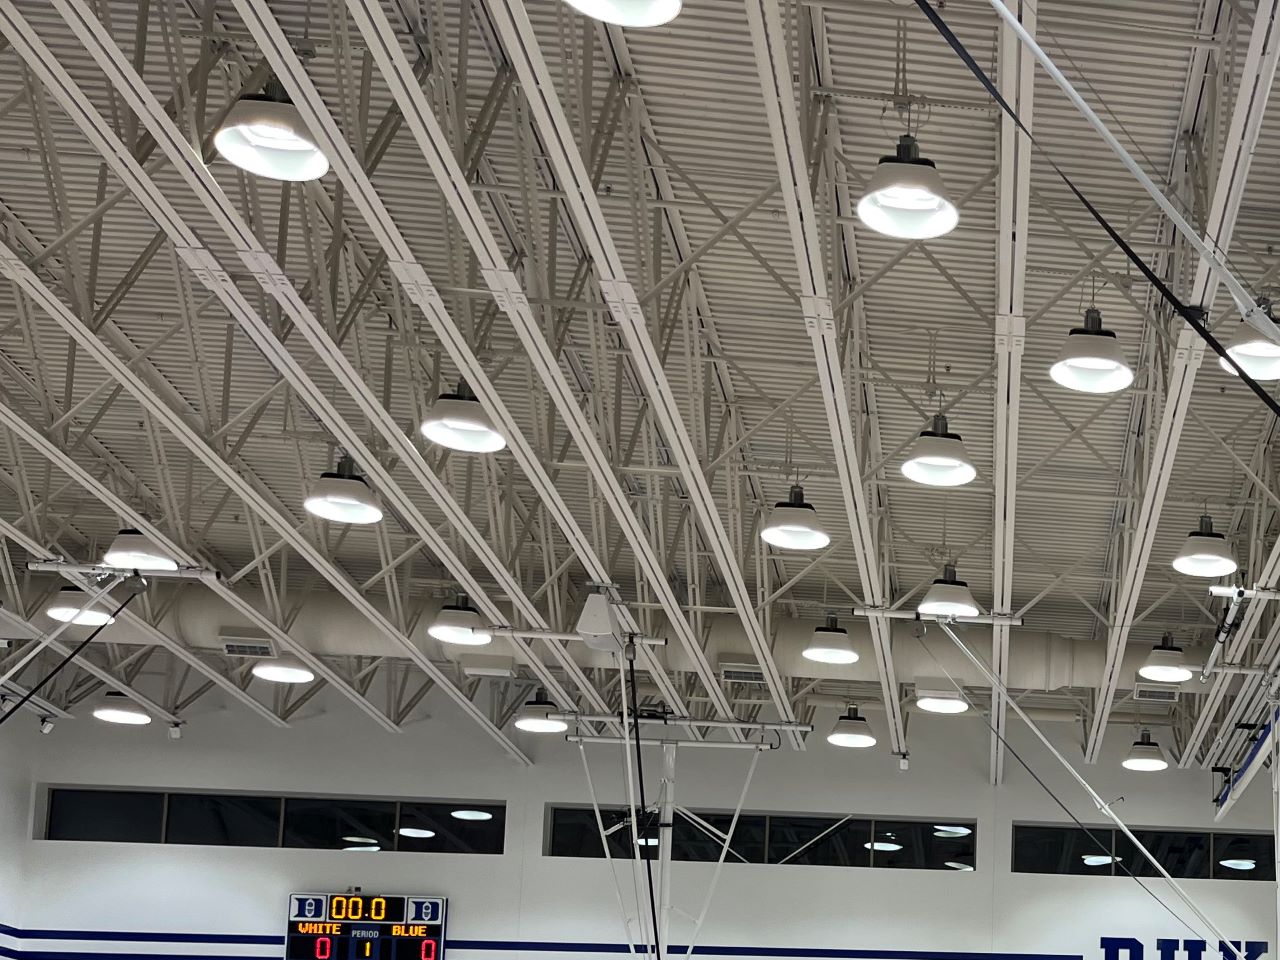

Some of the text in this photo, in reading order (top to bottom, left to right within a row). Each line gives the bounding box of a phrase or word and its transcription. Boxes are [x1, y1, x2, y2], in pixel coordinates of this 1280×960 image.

[331, 896, 386, 920] 00.0
[298, 923, 342, 934] WHITE
[352, 930, 379, 938] PERIOD
[392, 925, 427, 937] BLUE
[315, 937, 331, 959] 0
[364, 941, 371, 957] 1
